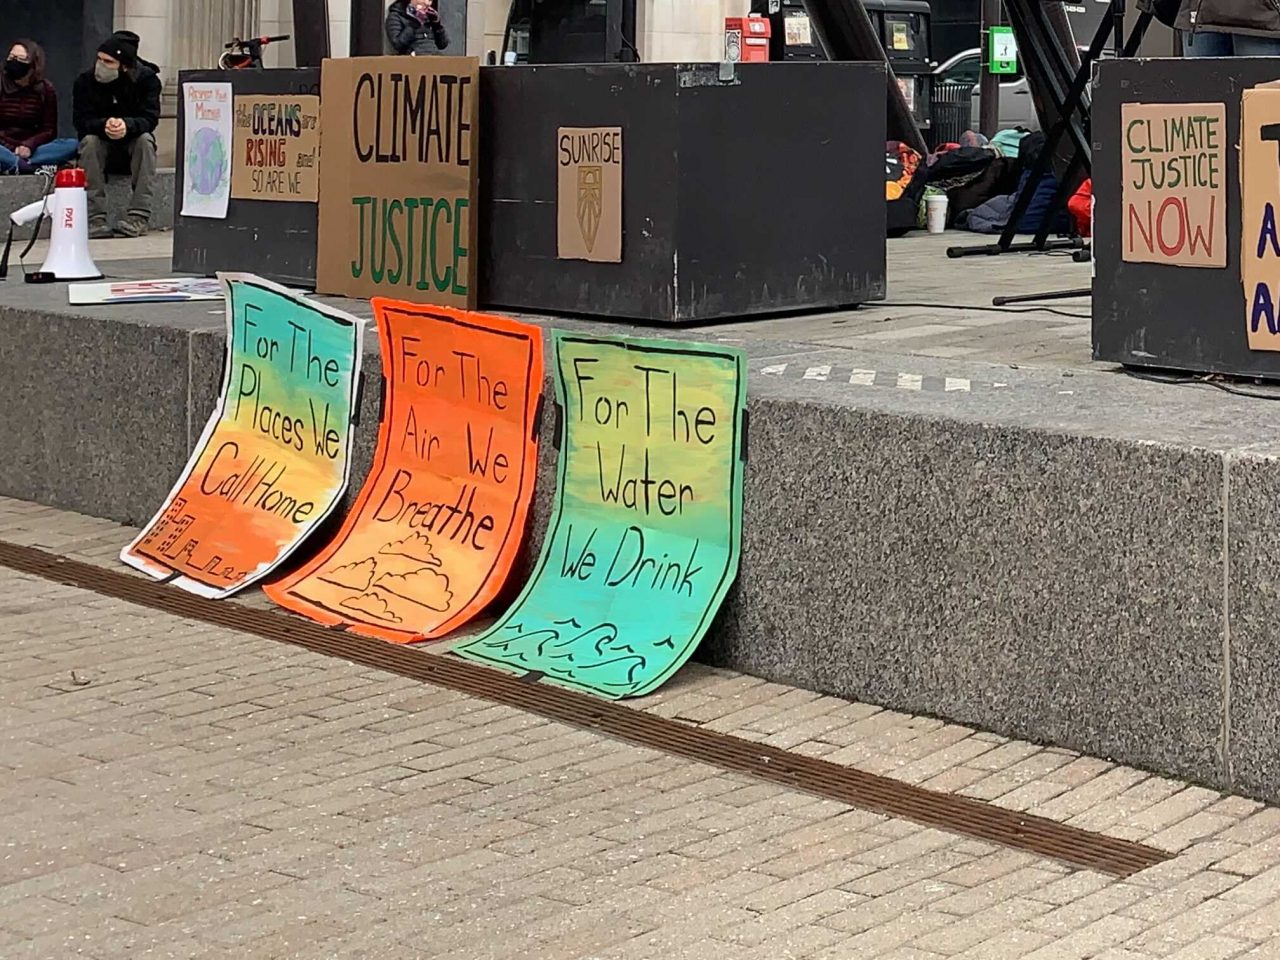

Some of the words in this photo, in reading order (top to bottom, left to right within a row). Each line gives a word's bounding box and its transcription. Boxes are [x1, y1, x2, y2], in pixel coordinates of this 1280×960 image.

[245, 139, 286, 167] RISING
[252, 103, 301, 137] OCEANS
[353, 72, 471, 166] CLIMATE
[559, 132, 621, 166] SUNRISE
[1127, 115, 1220, 154] CLIMATE
[251, 170, 264, 192] SO
[265, 171, 285, 193] ARE
[288, 172, 301, 194] WE
[1132, 153, 1220, 189] JUSTICE
[65, 207, 74, 228] PYLE
[351, 197, 469, 295] JUSTICE
[1129, 195, 1216, 257] NOW
[243, 304, 280, 361] For
[289, 320, 339, 388] The
[402, 337, 445, 386] For
[453, 351, 508, 410] The
[234, 364, 304, 452] Places
[307, 398, 341, 459] We
[573, 357, 629, 426] For
[634, 365, 716, 445] The
[402, 406, 439, 459] Air
[467, 424, 509, 484] We
[595, 442, 694, 516] Water
[201, 442, 262, 501] Call
[253, 458, 314, 524] Home
[373, 469, 494, 551] Breathe
[560, 525, 595, 581] We
[604, 527, 703, 597] Drink
